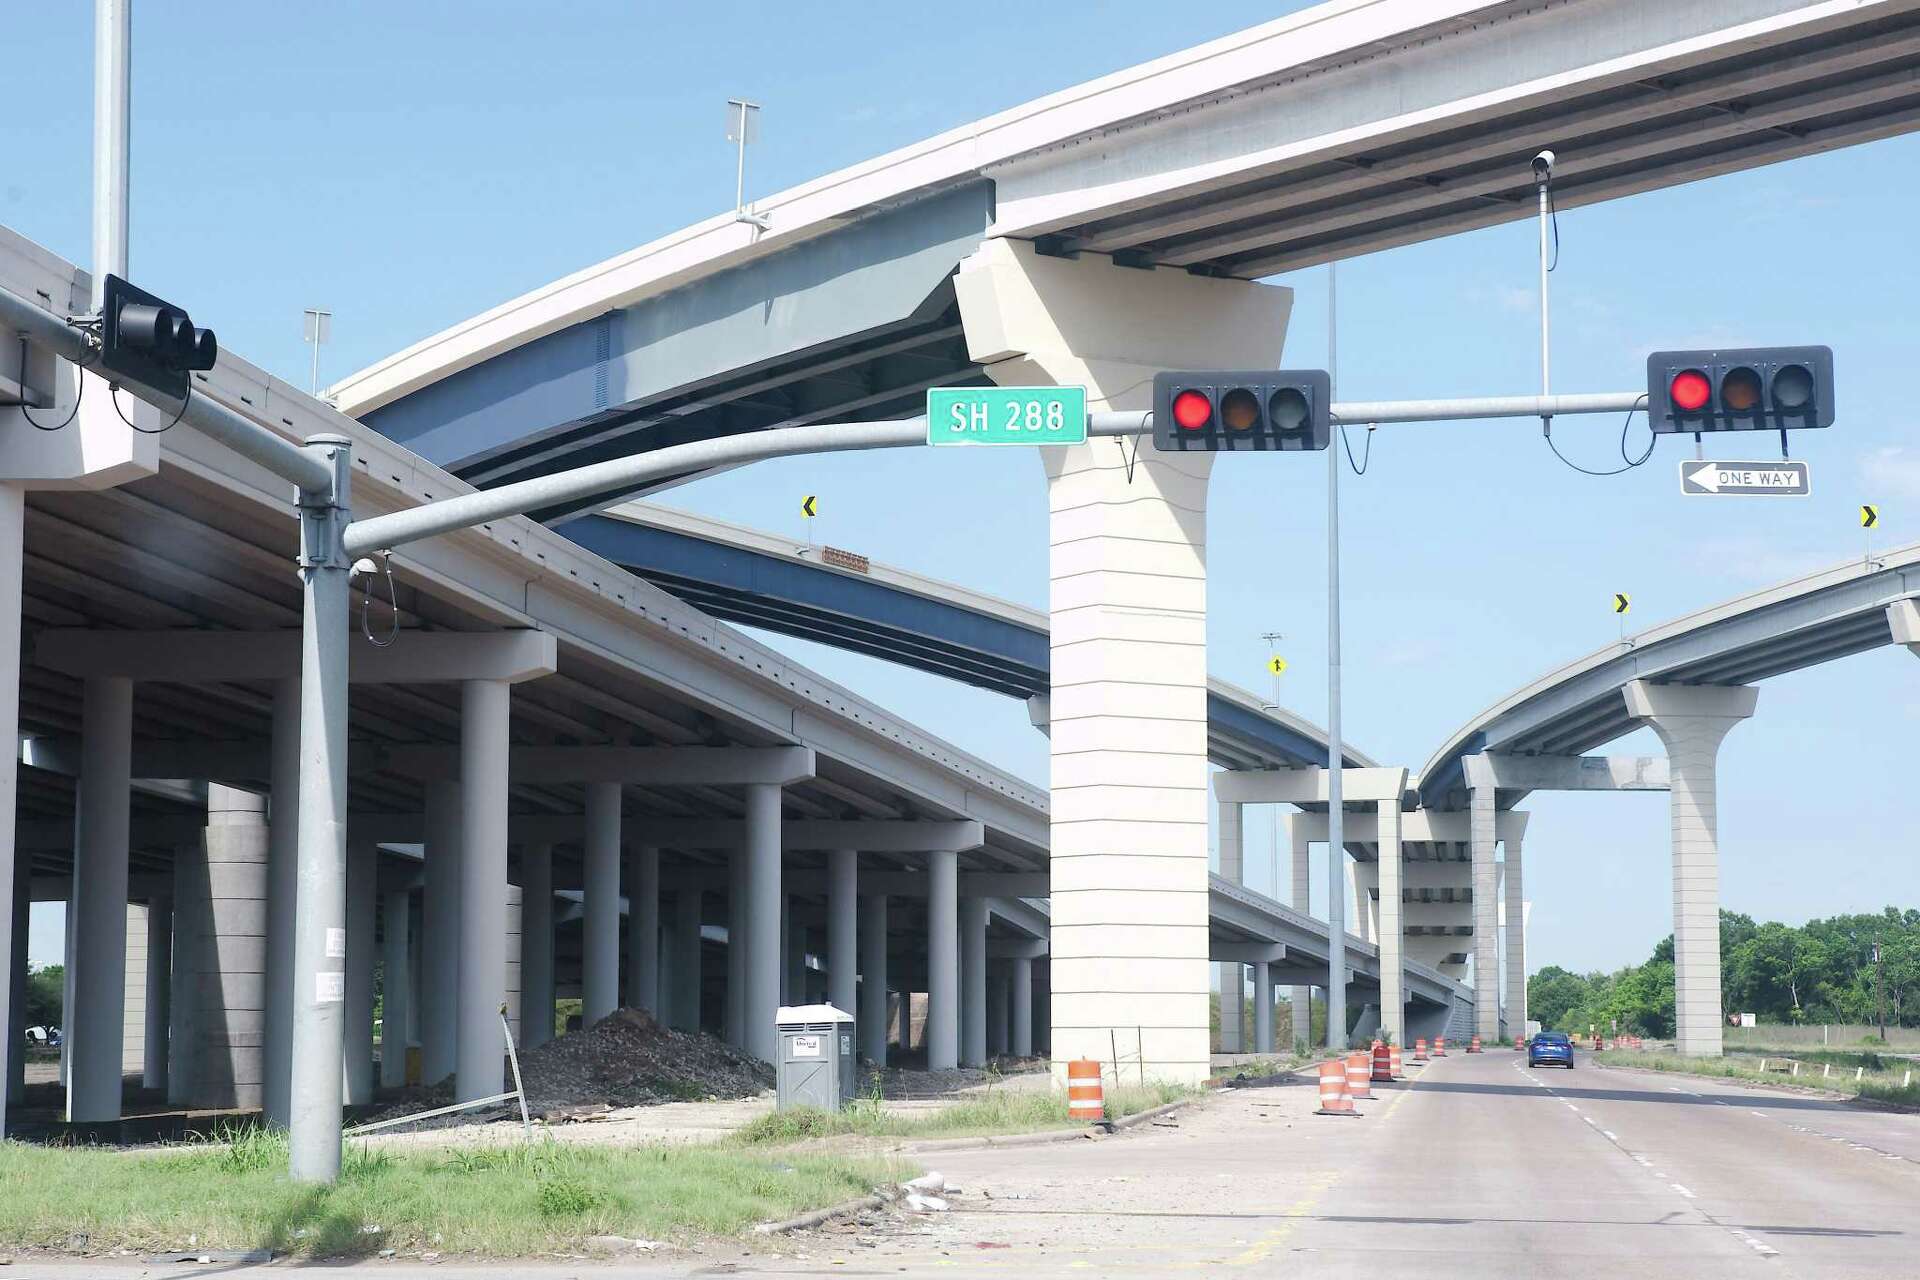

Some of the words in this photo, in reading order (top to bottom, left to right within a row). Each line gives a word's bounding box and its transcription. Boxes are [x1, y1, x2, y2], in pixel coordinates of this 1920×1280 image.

[950, 401, 988, 432] SH
[1005, 400, 1064, 431] 288
[1719, 472, 1752, 485] ONE
[1759, 472, 1793, 486] WAY
